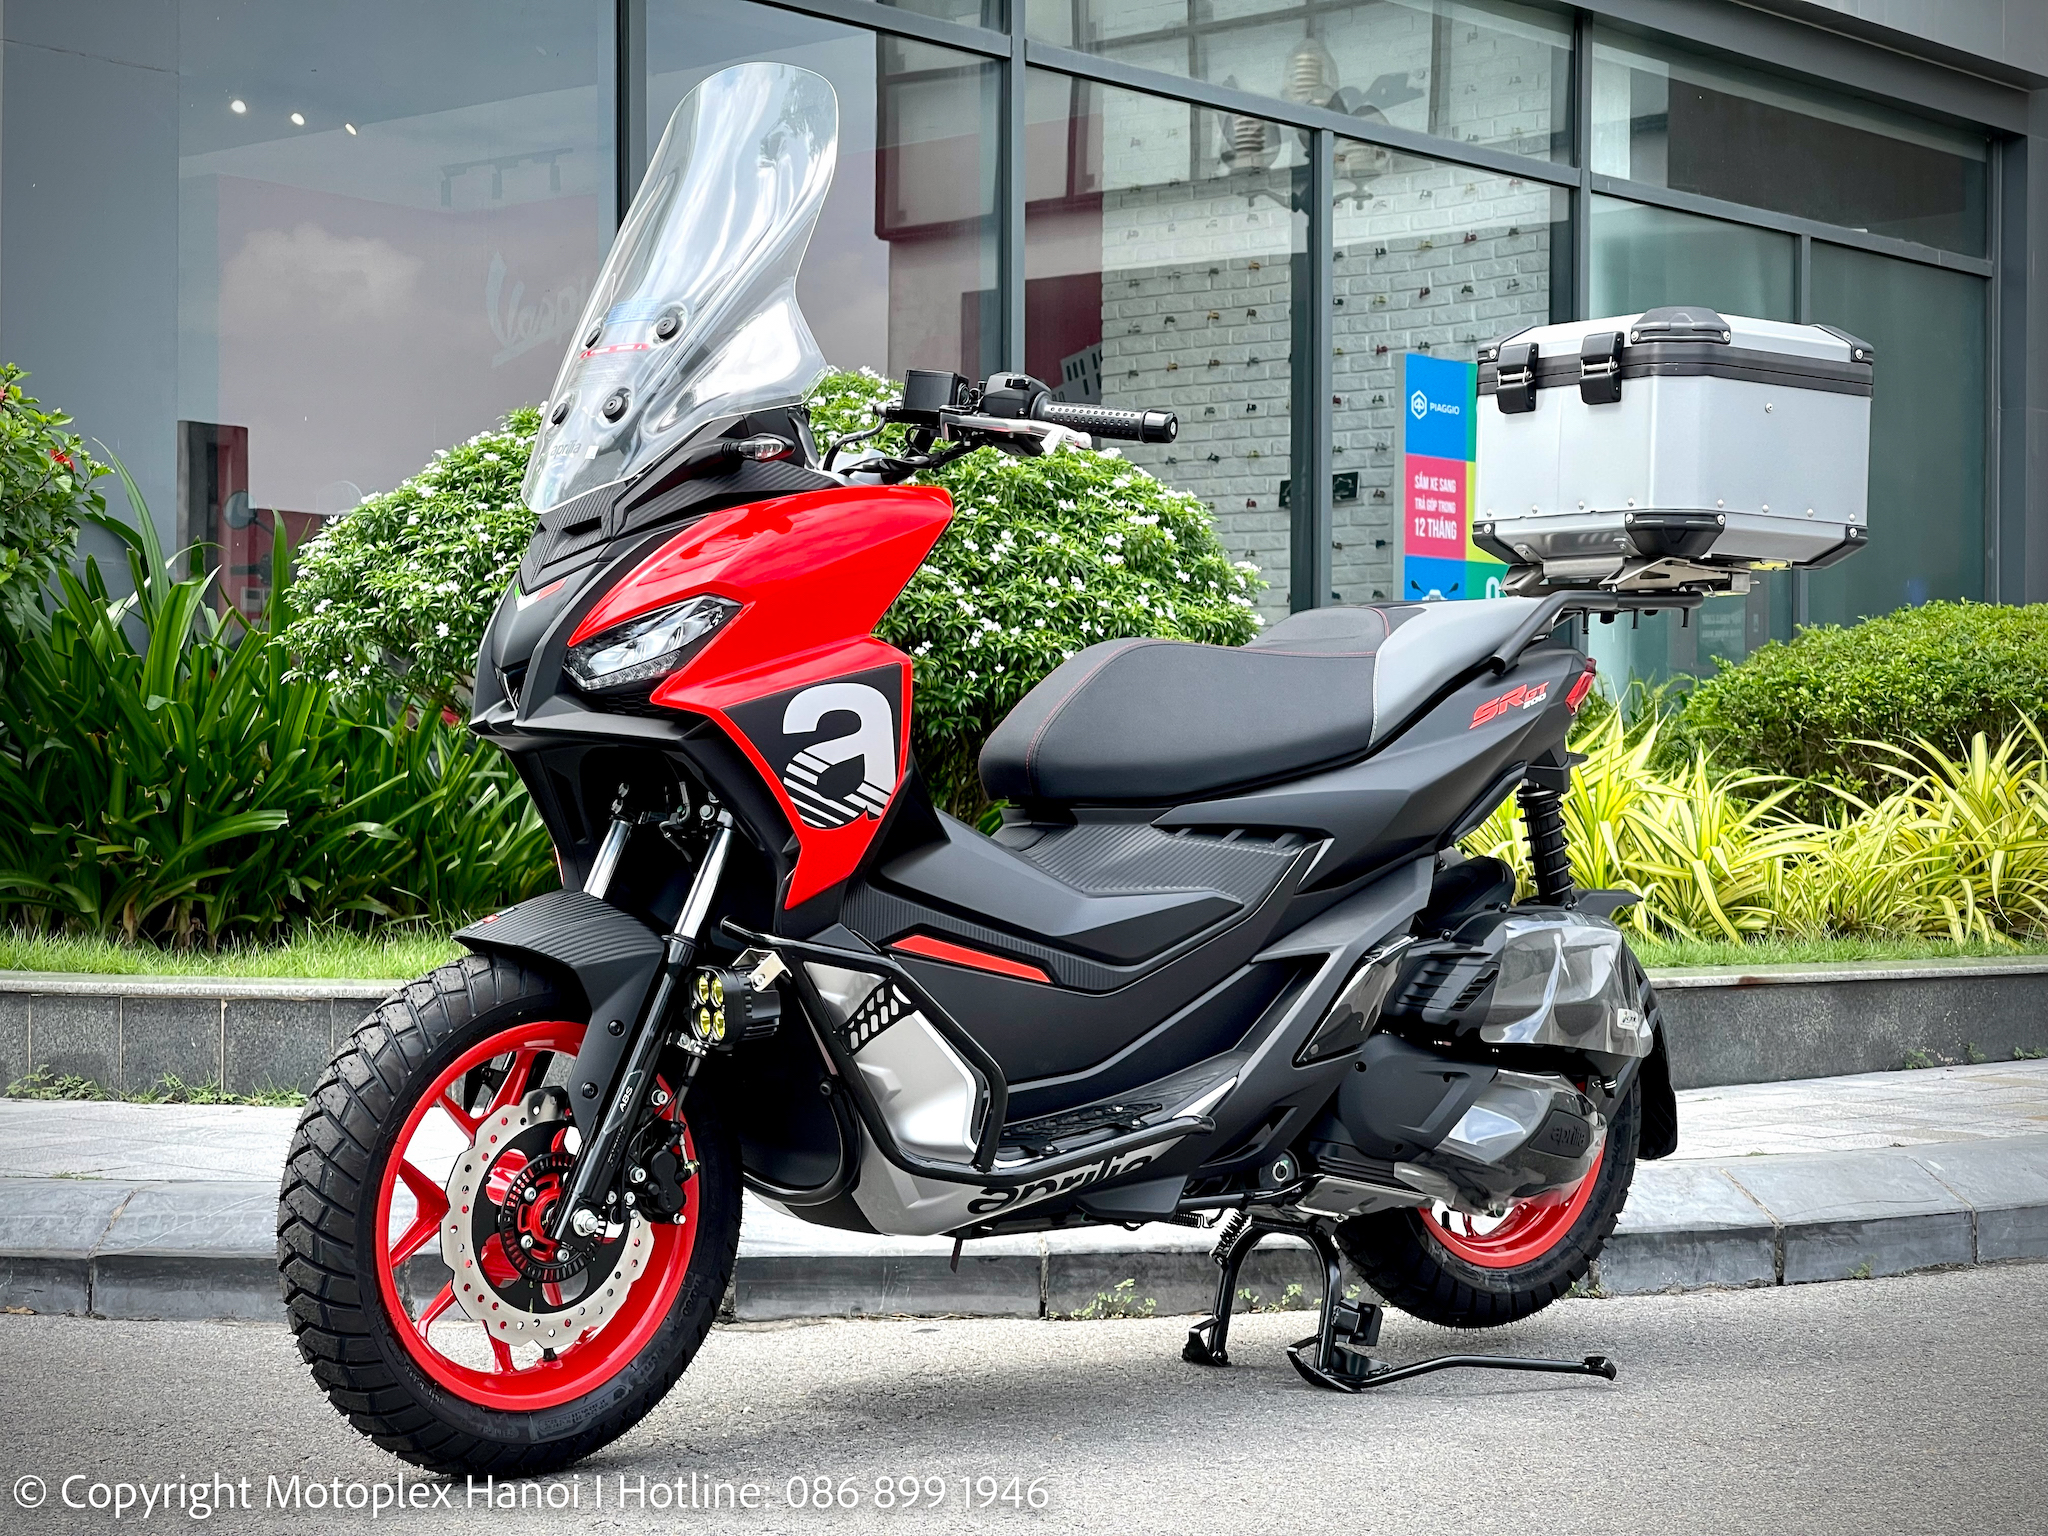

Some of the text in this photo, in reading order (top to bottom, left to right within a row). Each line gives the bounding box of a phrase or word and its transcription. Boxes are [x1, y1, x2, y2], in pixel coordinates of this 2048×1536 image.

[1429, 402, 1460, 416] PIAGGIO
[1430, 476, 1439, 491] XE
[1439, 477, 1457, 494] SANG
[1414, 515, 1457, 540] 12 THÁNG
[620, 1086, 633, 1112] ABS
[1551, 1125, 1586, 1147] aprilia
